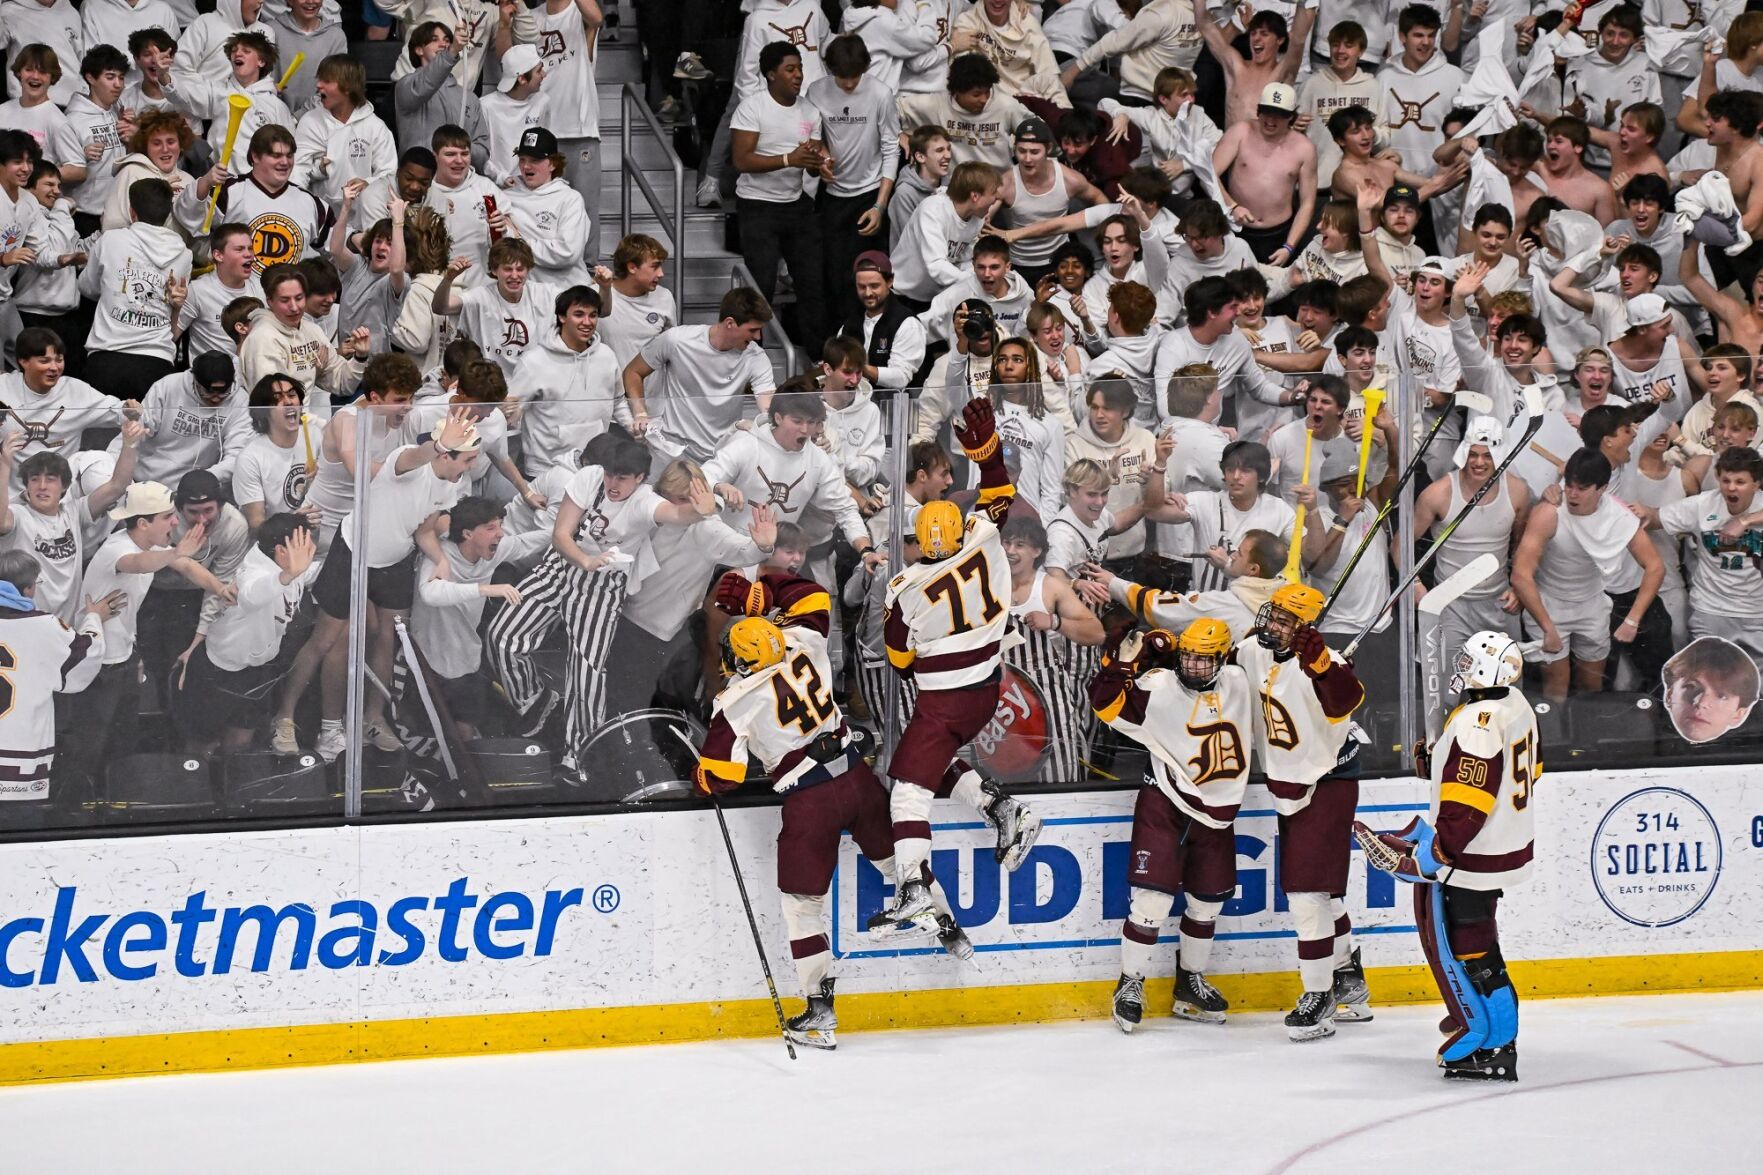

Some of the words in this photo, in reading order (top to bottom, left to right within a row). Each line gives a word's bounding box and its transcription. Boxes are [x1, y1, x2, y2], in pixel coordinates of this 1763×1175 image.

[1317, 98, 1326, 108] DE
[946, 120, 955, 130] DE
[957, 122, 975, 131] SMET
[977, 122, 1001, 132] JESUIT
[501, 317, 530, 348] D
[1625, 386, 1641, 399] DE
[1122, 455, 1141, 468] ESUIT
[925, 548, 1003, 636] 77
[1427, 625, 1440, 716] VAPOR
[771, 652, 835, 736] 42
[1187, 720, 1247, 786] D
[1337, 744, 1361, 767] auer
[1456, 756, 1488, 788] 50
[1636, 812, 1680, 833] 314
[1607, 841, 1708, 876] SOCIAL
[1619, 885, 1644, 895] EATS
[1658, 883, 1697, 894] DRINKS
[1448, 964, 1475, 1020] TRUE
